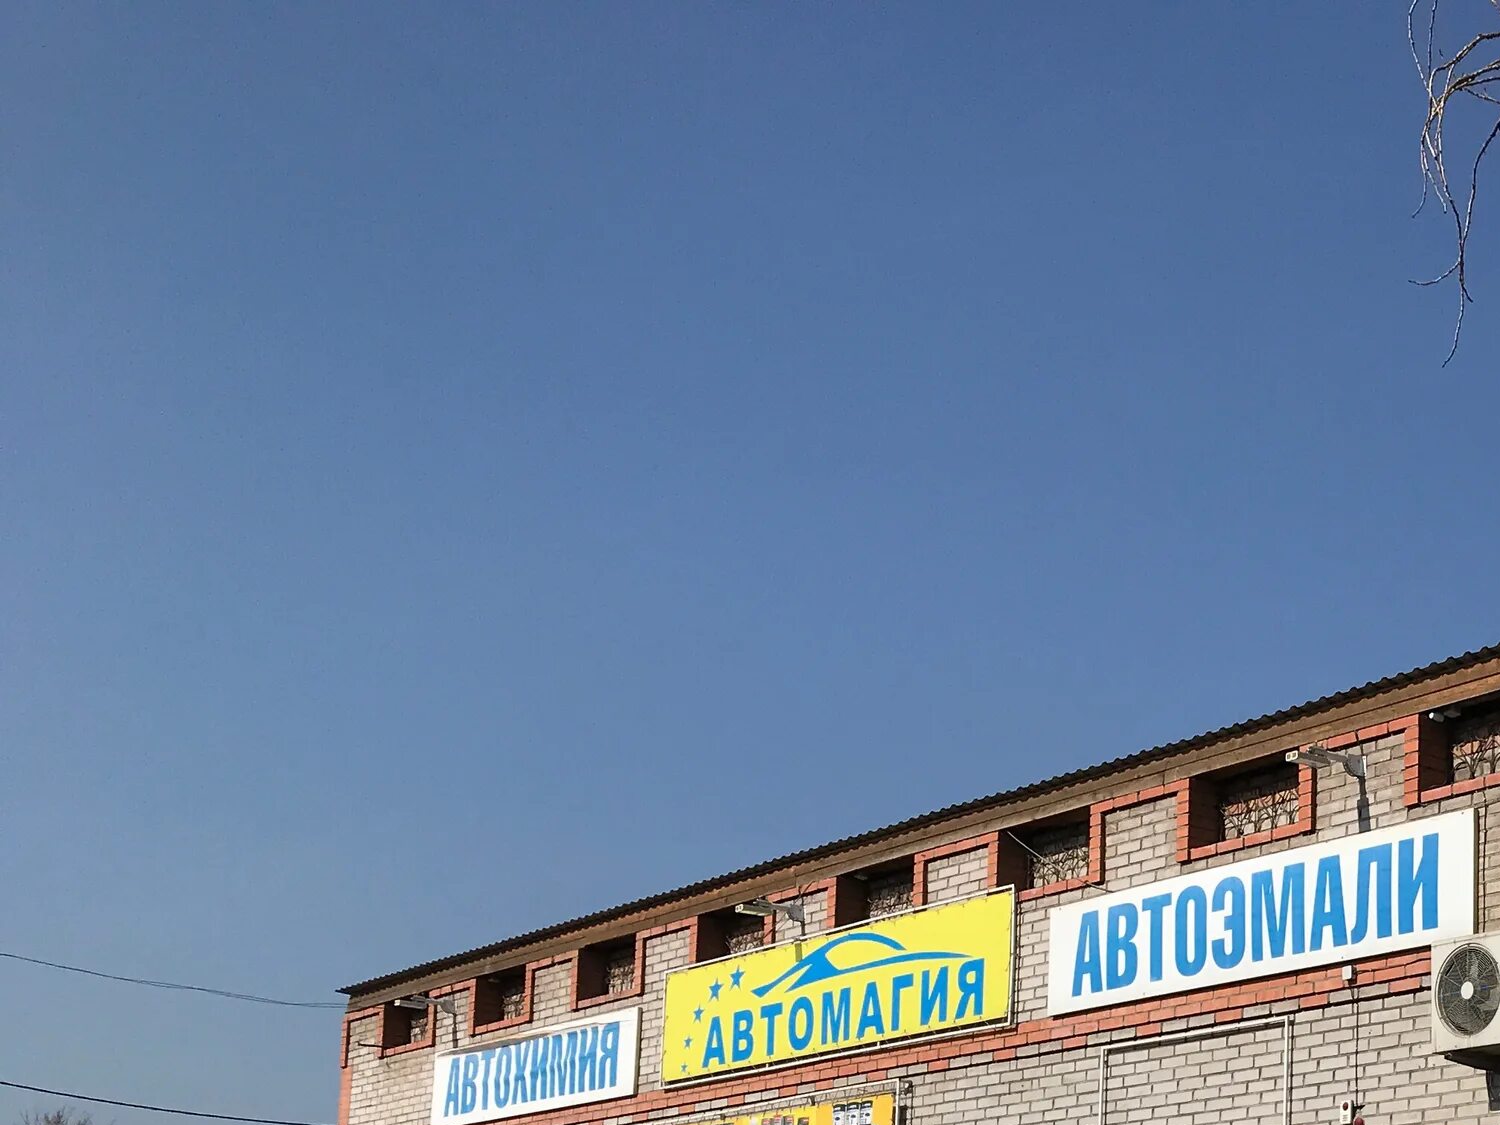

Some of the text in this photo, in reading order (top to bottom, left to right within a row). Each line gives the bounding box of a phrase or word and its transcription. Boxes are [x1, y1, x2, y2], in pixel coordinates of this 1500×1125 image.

[1070, 832, 1440, 998] АВТОЭМАЛИ
[701, 957, 986, 1069] АВТОМАГИЯ
[443, 1021, 621, 1118] АВТОХИМИЯ
